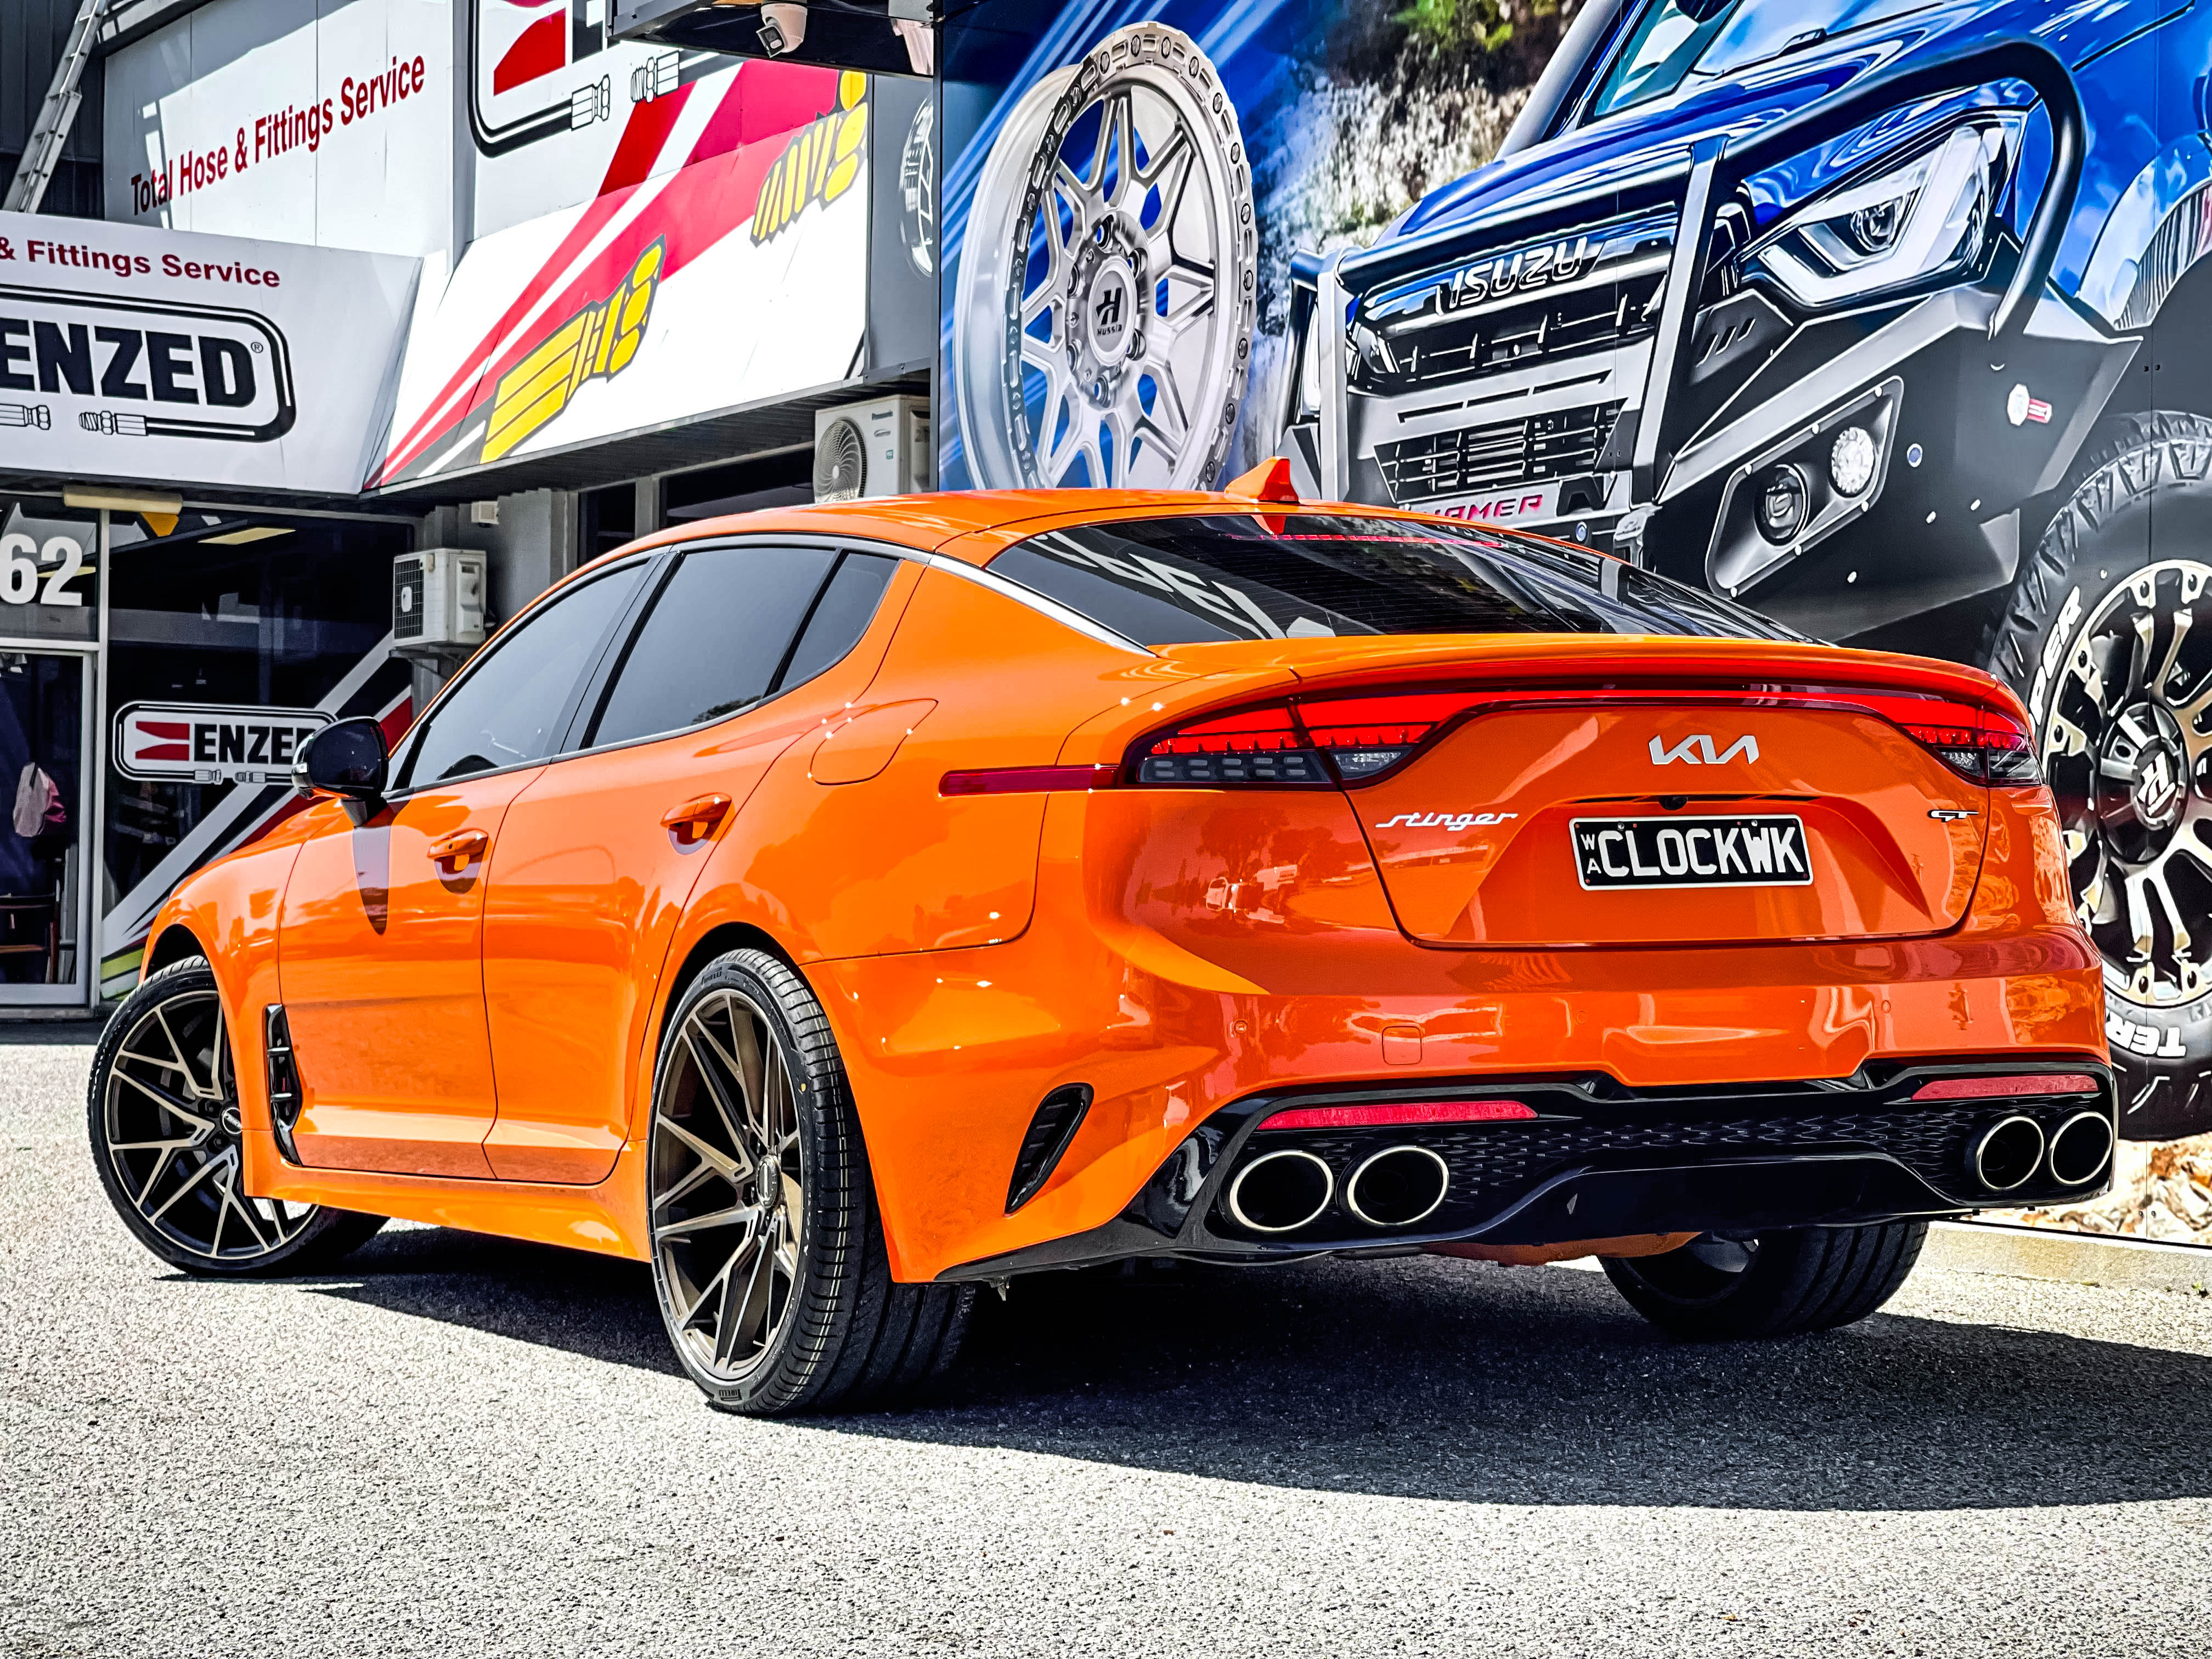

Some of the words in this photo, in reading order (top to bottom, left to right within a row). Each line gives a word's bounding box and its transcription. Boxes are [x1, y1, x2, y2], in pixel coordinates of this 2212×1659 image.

[131, 160, 172, 215] Total
[180, 146, 228, 196] Hose
[234, 127, 248, 173] &
[255, 98, 332, 163] Fittings
[341, 55, 425, 125] Service
[0, 236, 16, 259] &
[27, 240, 150, 277] Fittings
[161, 254, 280, 287] Service
[1449, 236, 1587, 309] ISUZU
[0, 533, 82, 606] 62
[1649, 735, 1759, 764] KIA
[1375, 812, 1519, 831] stinger
[1598, 827, 1804, 877] CLOCKWK
[2105, 1008, 2186, 1057] TER
